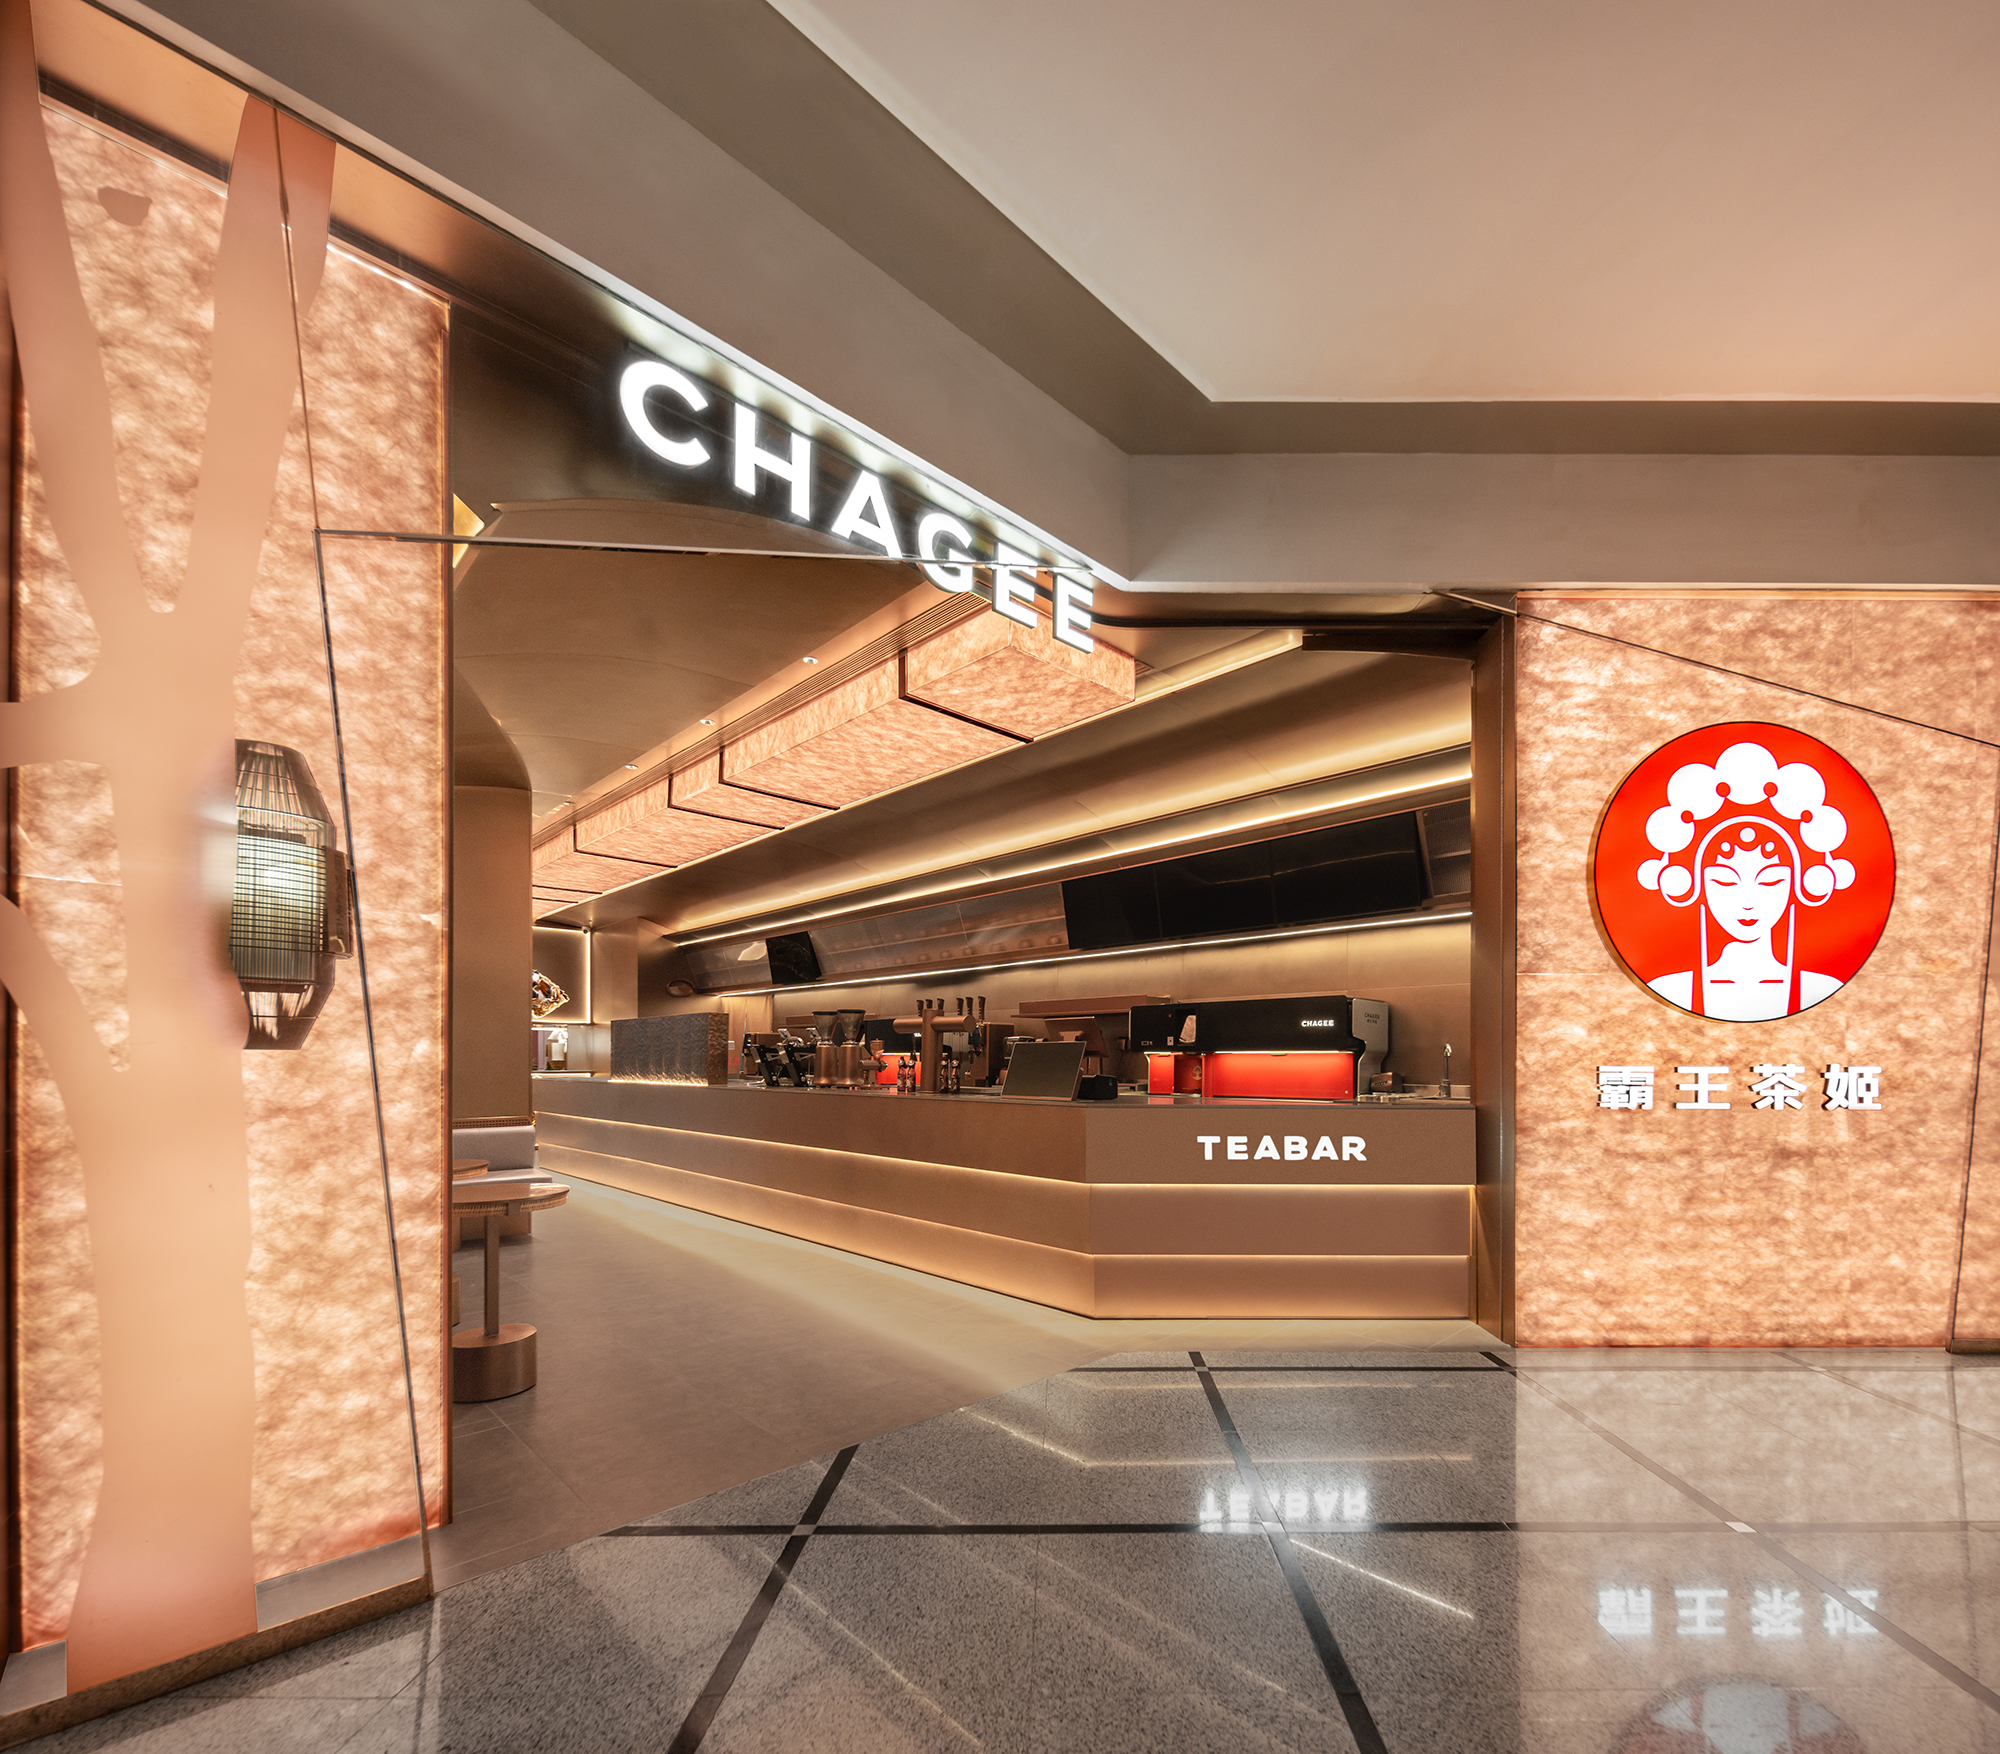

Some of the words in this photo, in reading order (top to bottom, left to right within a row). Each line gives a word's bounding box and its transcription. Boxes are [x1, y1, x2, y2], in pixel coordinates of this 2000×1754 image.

[619, 360, 1094, 654] CHAGEE
[1301, 1019, 1335, 1028] CHAGEE
[1597, 1063, 1882, 1110] 霸王茶姬
[1196, 1135, 1367, 1161] TEABAR
